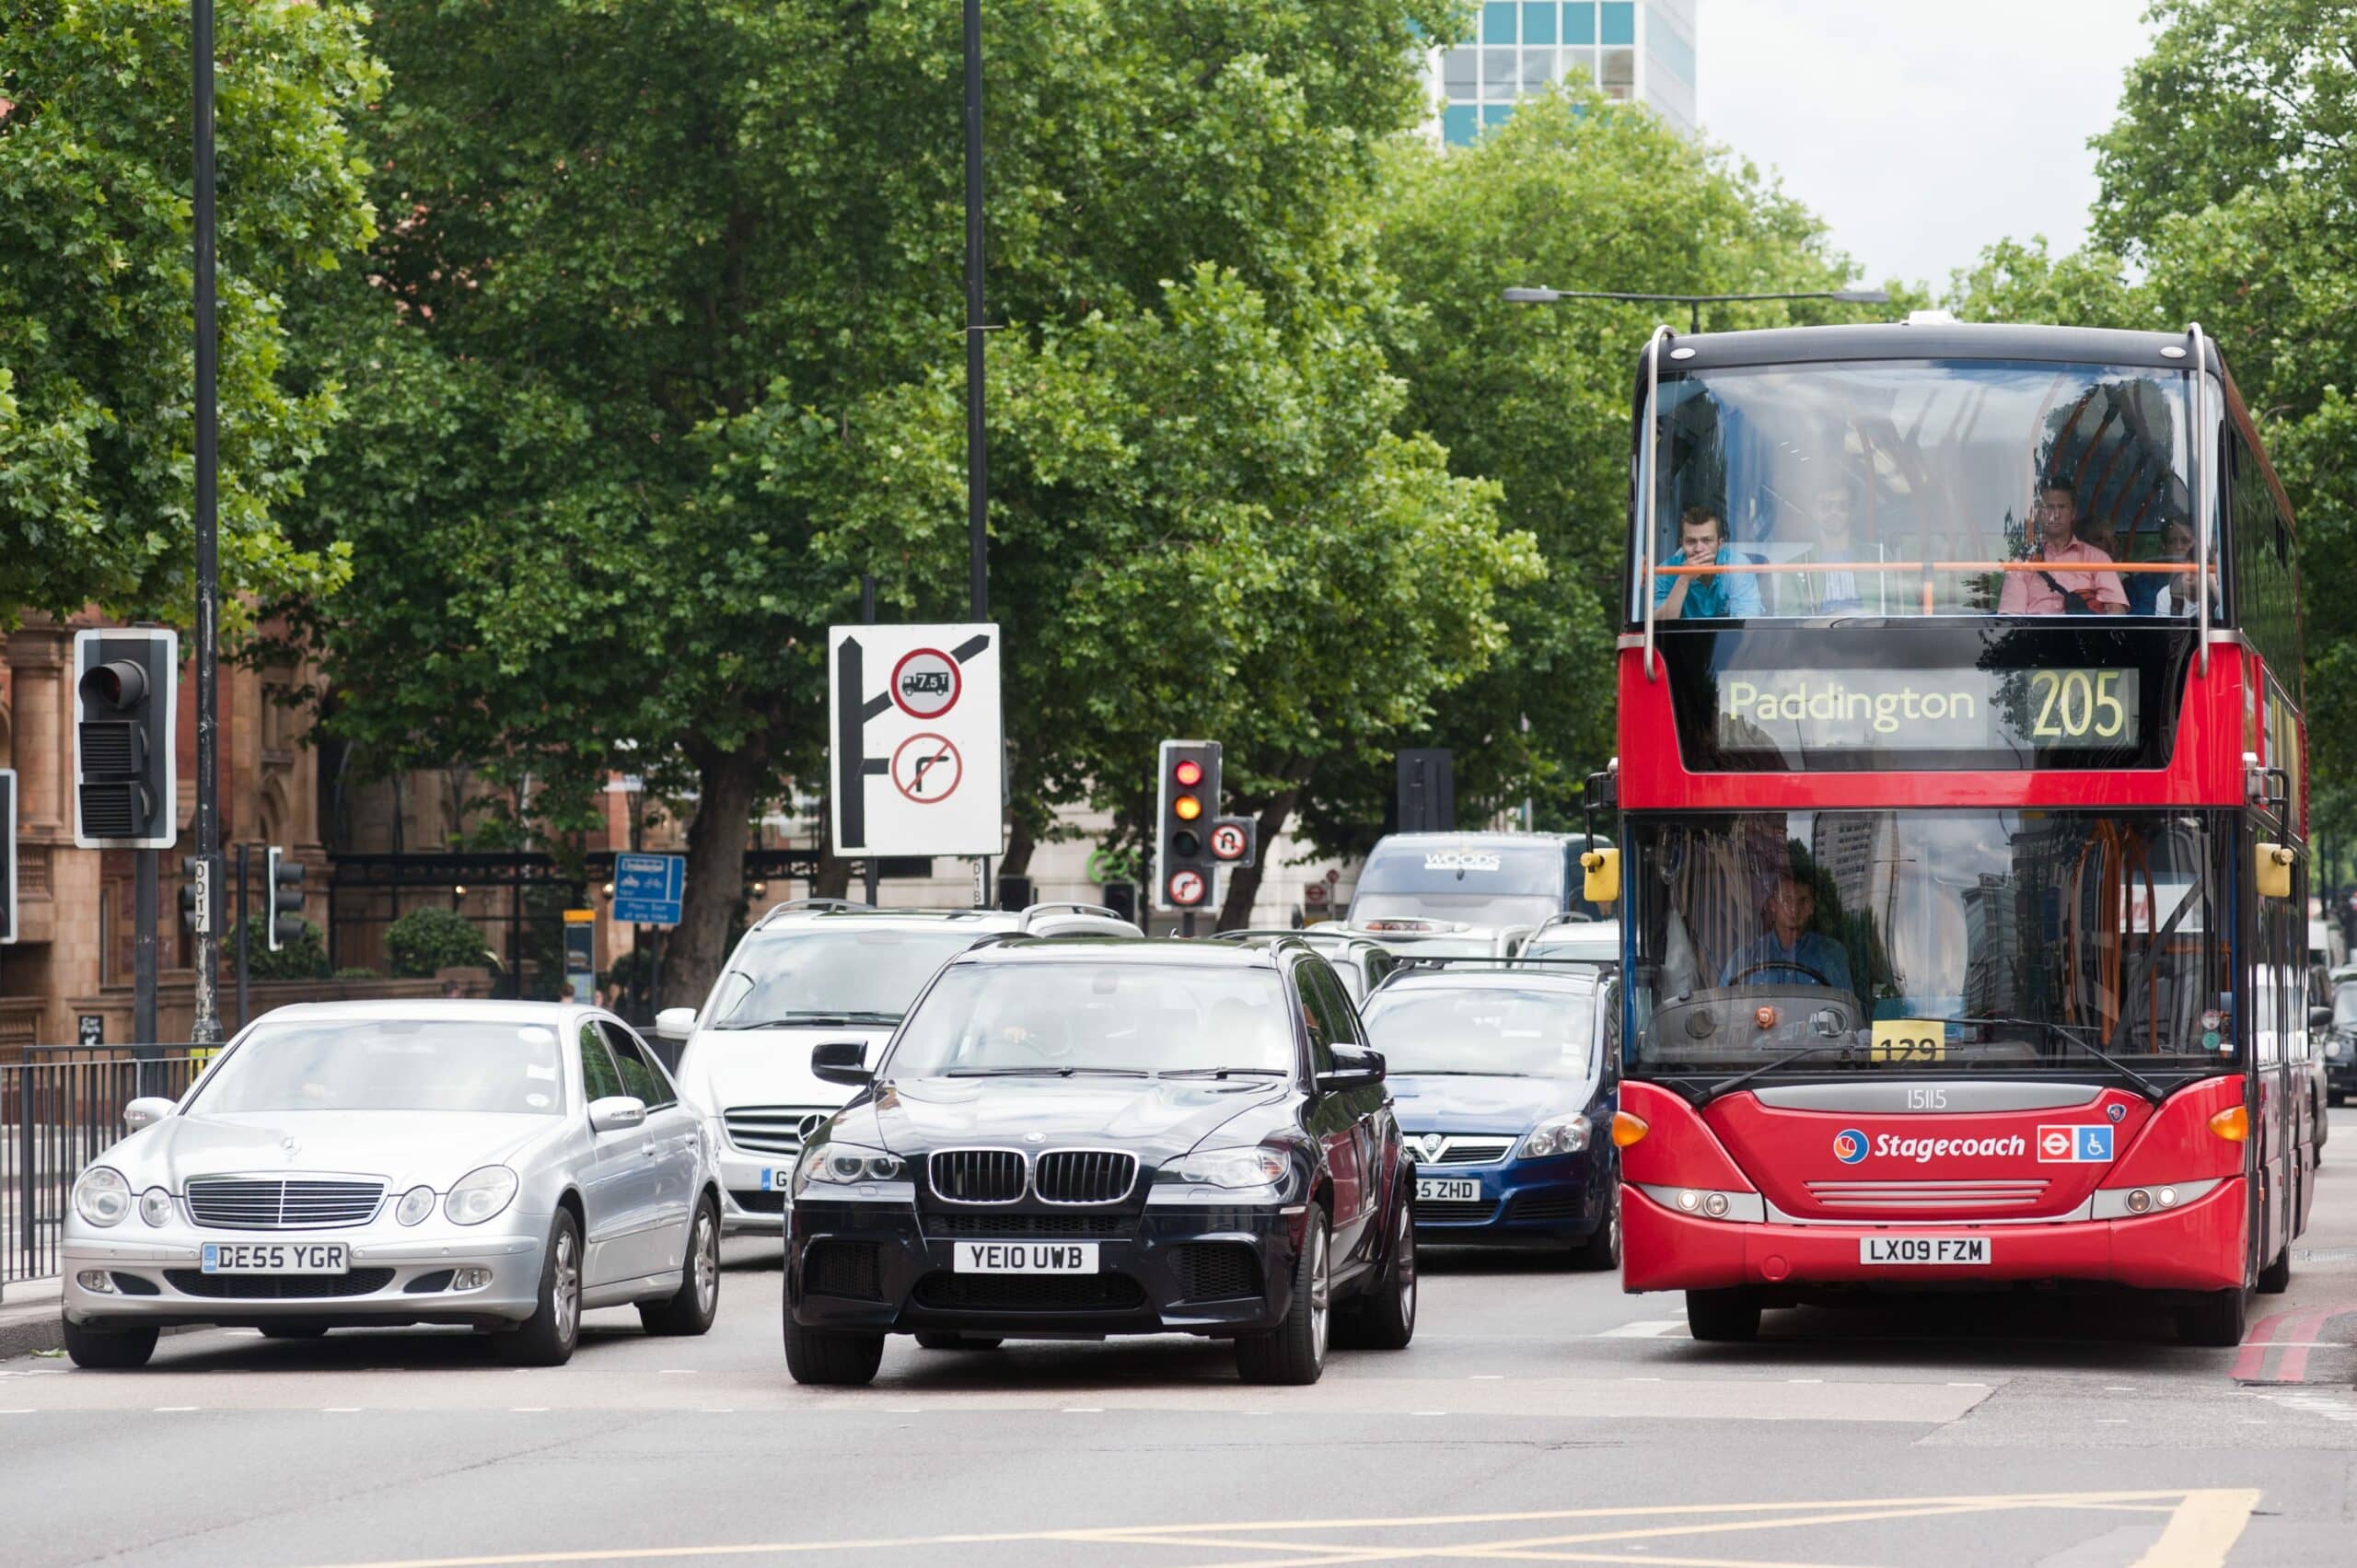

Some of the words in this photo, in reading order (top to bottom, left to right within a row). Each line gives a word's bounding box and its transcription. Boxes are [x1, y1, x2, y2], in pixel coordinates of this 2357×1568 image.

[1728, 681, 1974, 734] Paddington
[2032, 670, 2123, 737] 205
[1424, 854, 1501, 865] WOODS
[1381, 922, 1419, 931] TAXI
[1880, 1038, 1936, 1062] 129
[1908, 1089, 1946, 1109] 15115
[1875, 1133, 2026, 1163] Stagecoach
[1437, 1181, 1473, 1198] ZHD
[219, 1247, 284, 1268] DE55
[294, 1247, 343, 1268] YGR
[970, 1246, 1026, 1269] YE10
[1033, 1246, 1083, 1269] UWB
[1871, 1240, 1930, 1260] LX09
[1938, 1240, 1982, 1260] FZM
